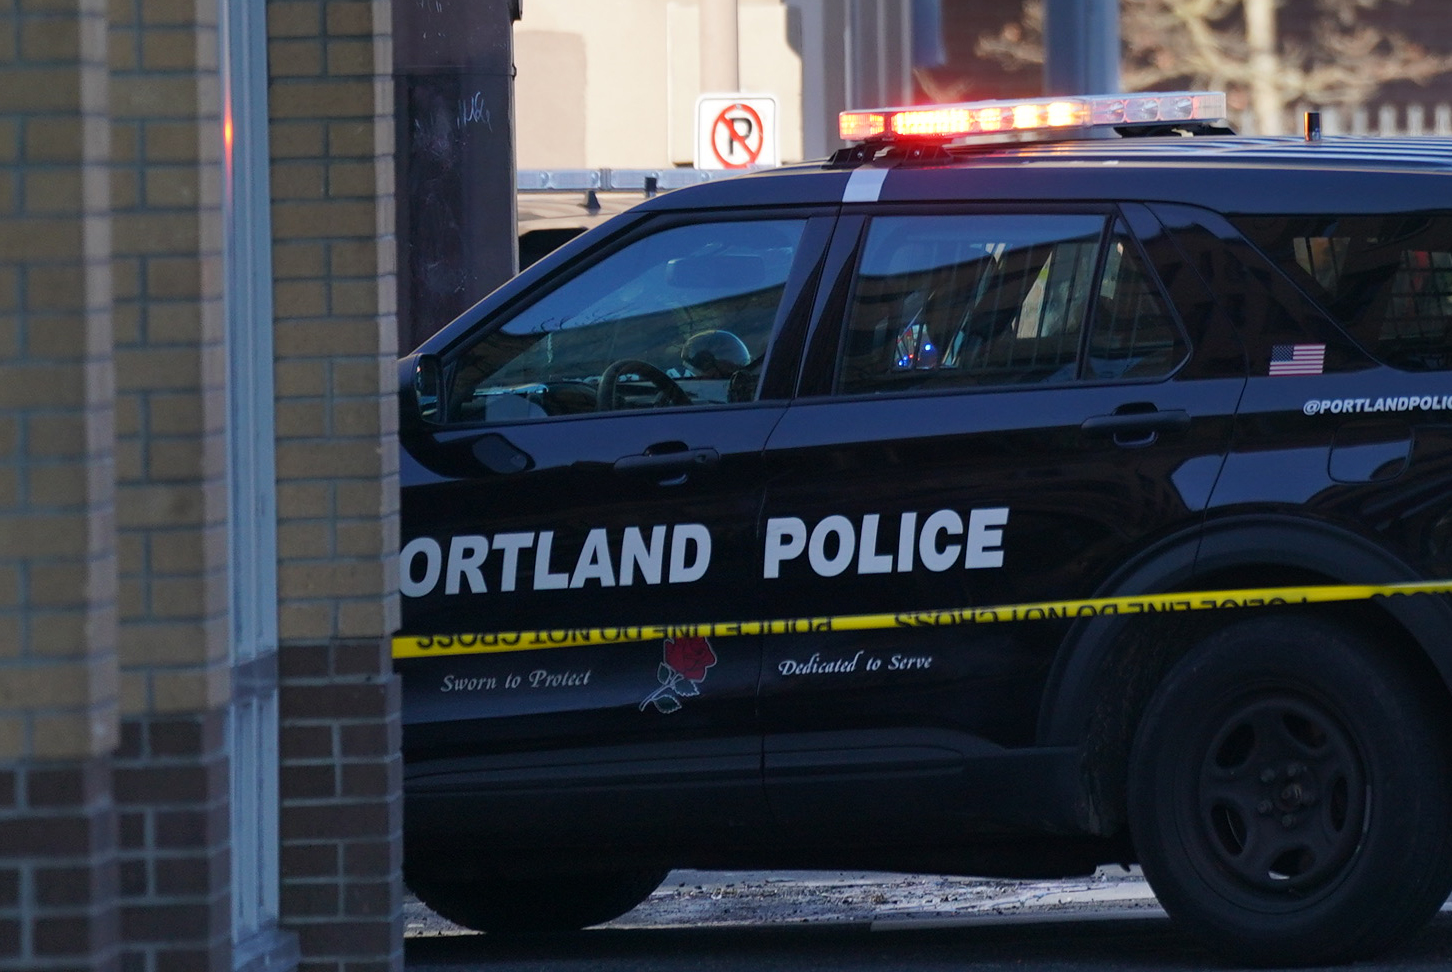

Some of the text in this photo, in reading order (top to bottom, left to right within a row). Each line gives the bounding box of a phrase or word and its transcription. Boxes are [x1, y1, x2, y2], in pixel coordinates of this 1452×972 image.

[763, 508, 1009, 579] POLICE
[778, 651, 932, 677] Dedicated to Serve
[440, 668, 591, 694] Sworn to Protect
